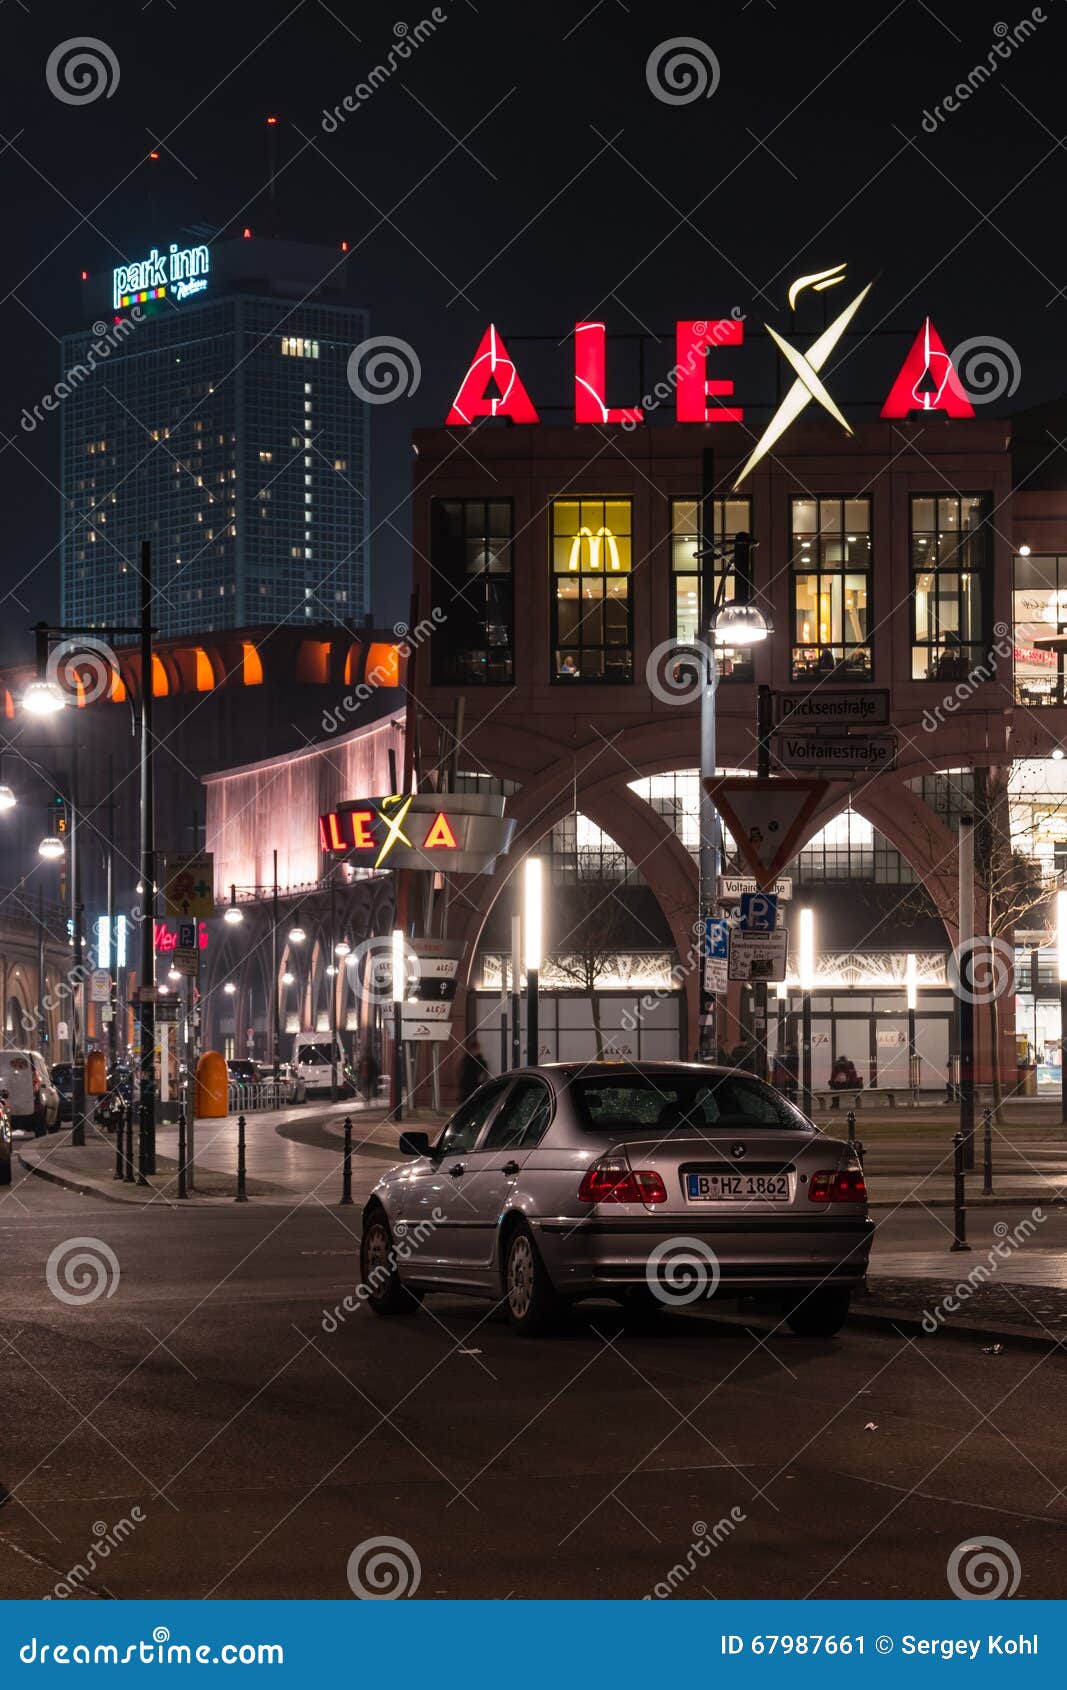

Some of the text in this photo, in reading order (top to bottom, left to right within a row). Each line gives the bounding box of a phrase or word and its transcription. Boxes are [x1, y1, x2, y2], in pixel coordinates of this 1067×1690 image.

[114, 244, 209, 310] park inn
[444, 262, 977, 491] ALEXA
[783, 699, 876, 718] Dircksenstraße
[787, 742, 887, 761] Voltairestraße
[749, 899, 769, 926] P
[700, 1177, 786, 1194] B HZ 1862
